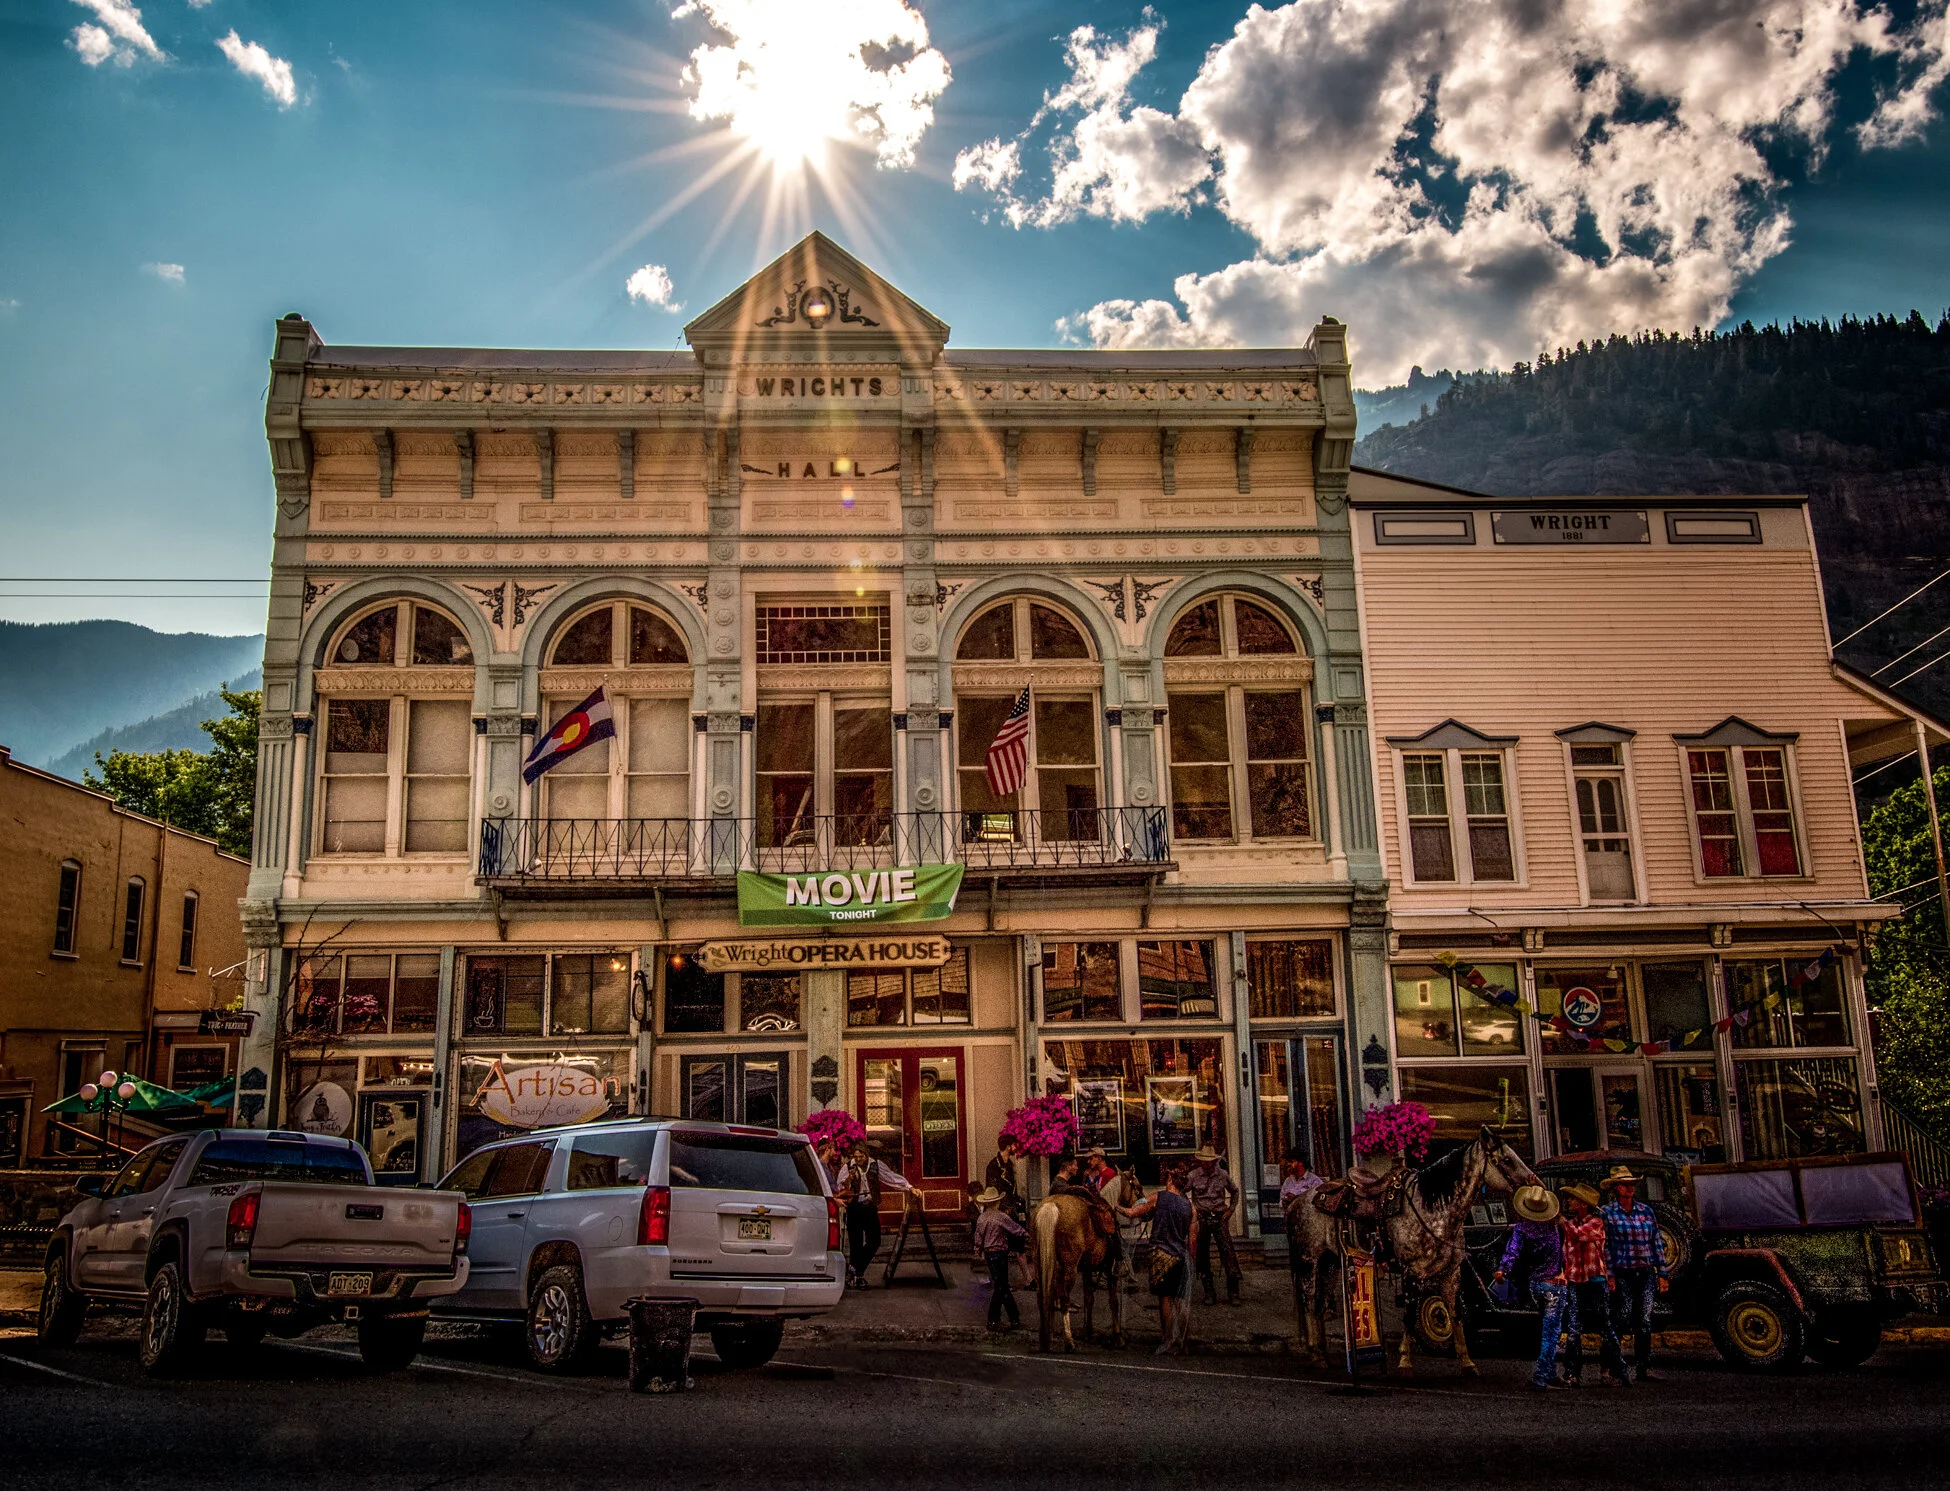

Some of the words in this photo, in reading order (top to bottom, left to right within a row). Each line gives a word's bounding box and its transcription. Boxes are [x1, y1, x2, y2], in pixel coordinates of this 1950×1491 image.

[756, 377, 882, 397] WRIGHTS
[778, 462, 865, 478] HALL
[1529, 515, 1612, 530] WRIGHT
[1562, 532, 1583, 540] 1881
[786, 870, 917, 907] MOVIE
[829, 909, 877, 920] TONIGHT
[723, 943, 790, 967] Wright
[788, 943, 867, 963] OPERA
[869, 941, 941, 961] HOUSE
[469, 1059, 622, 1107] Artisan
[299, 1245, 415, 1257] TACOMA
